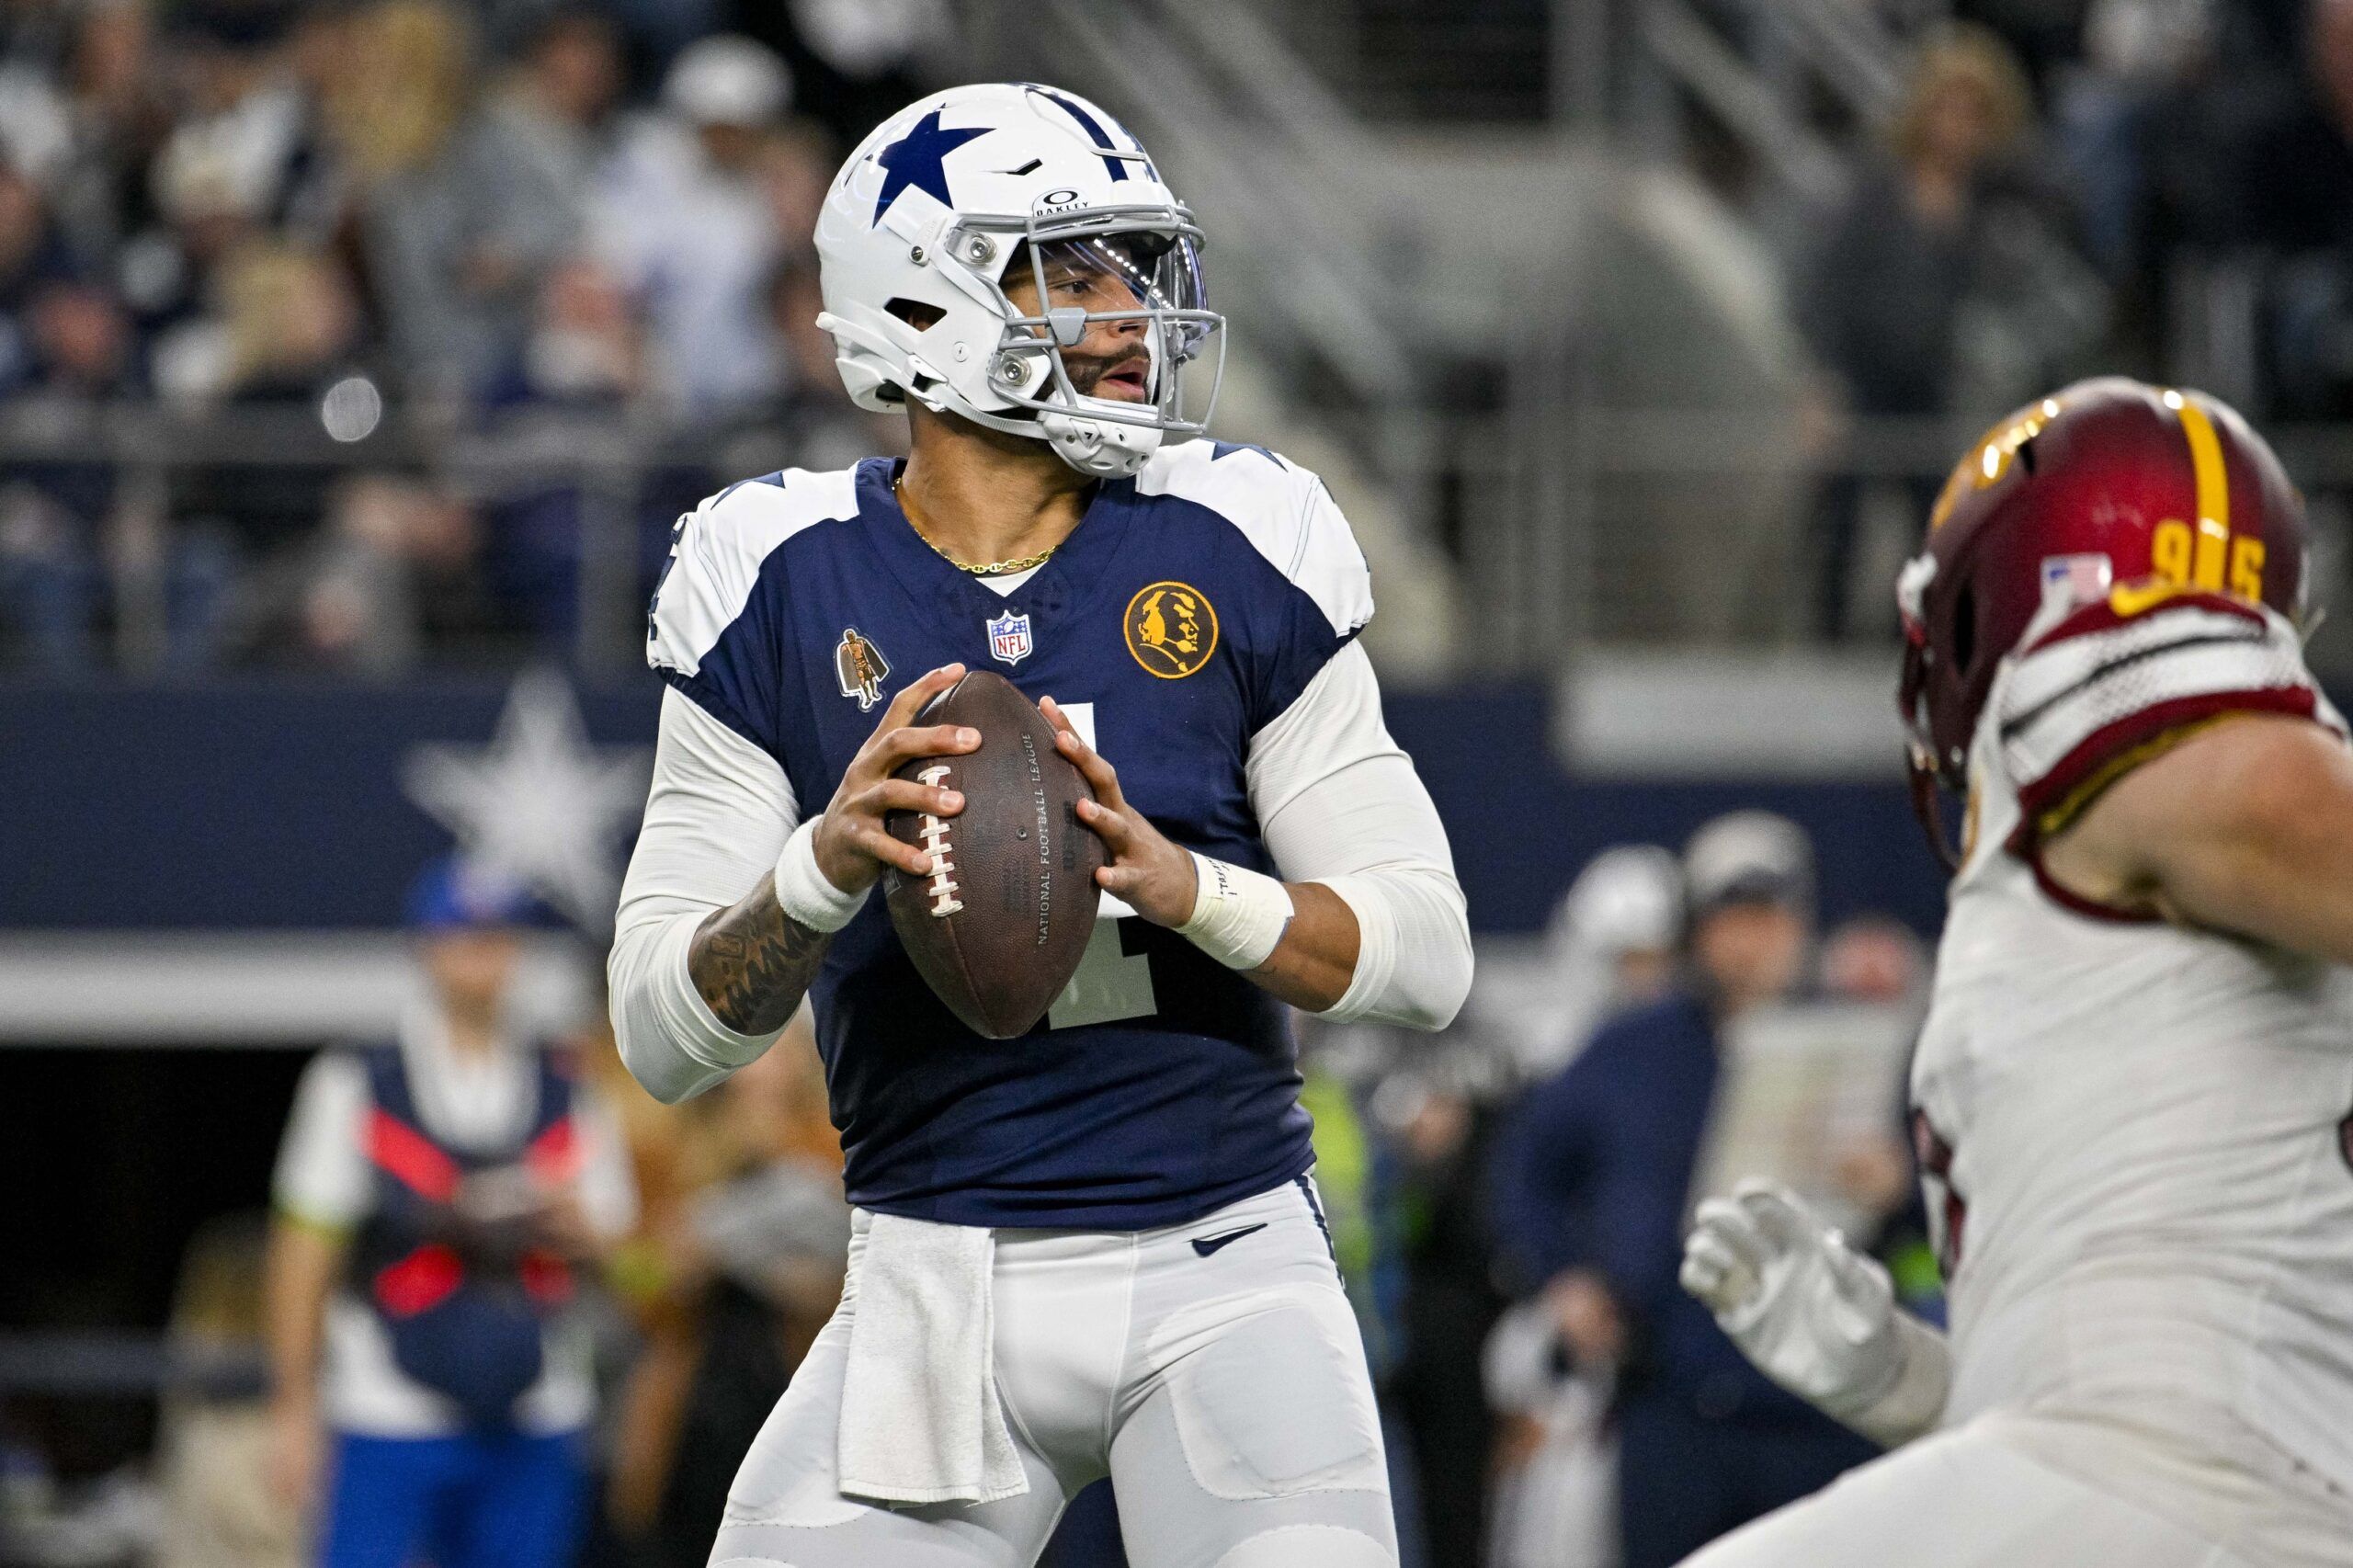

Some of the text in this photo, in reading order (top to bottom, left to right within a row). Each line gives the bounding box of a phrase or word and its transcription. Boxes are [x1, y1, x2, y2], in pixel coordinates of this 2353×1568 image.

[1036, 201, 1088, 217] OAKLEY
[996, 635, 1026, 655] NFL
[1022, 733, 1051, 946] NATIONAL FOOTBALL LEAGUE
